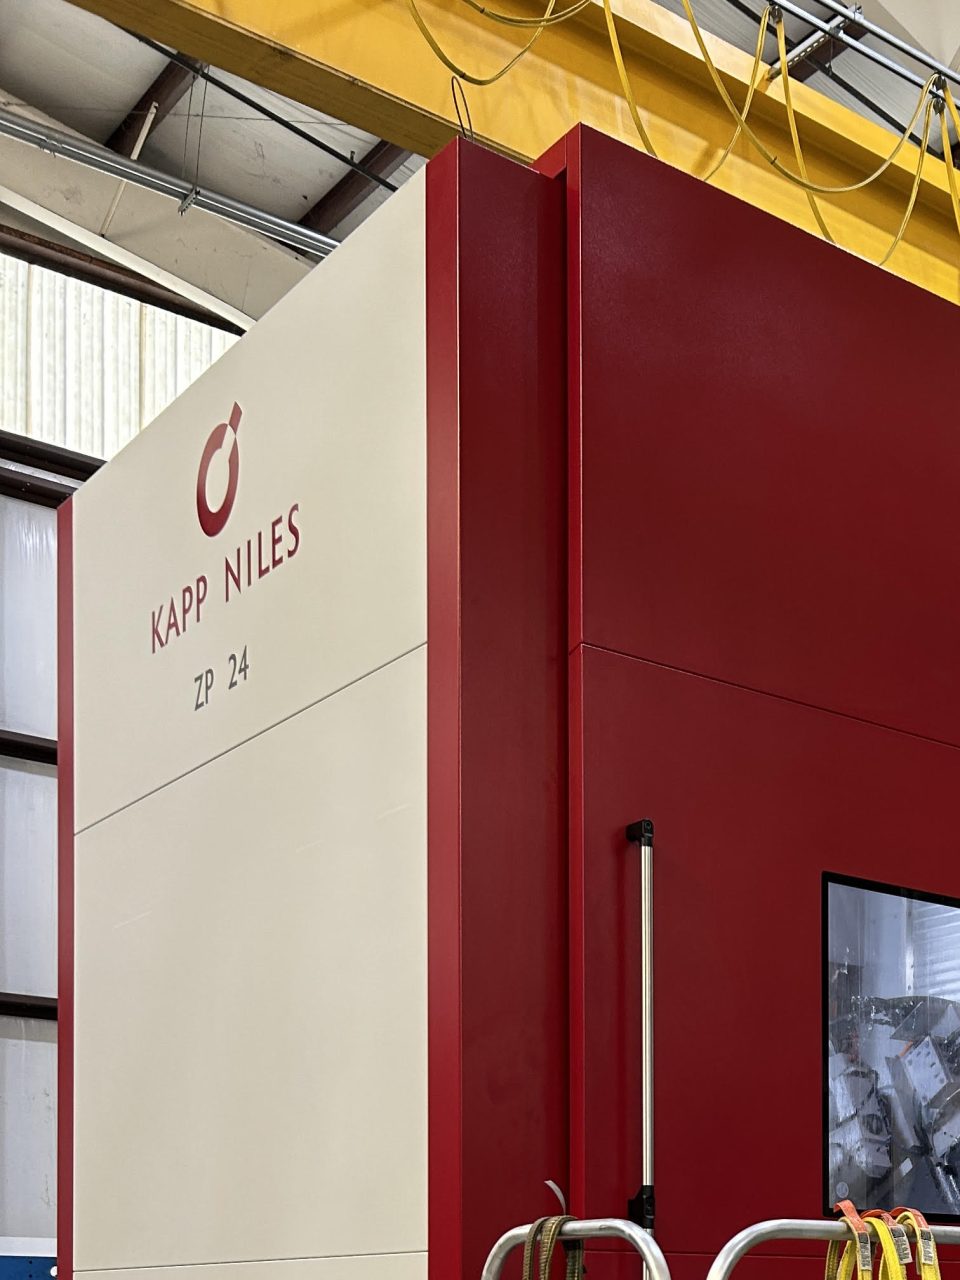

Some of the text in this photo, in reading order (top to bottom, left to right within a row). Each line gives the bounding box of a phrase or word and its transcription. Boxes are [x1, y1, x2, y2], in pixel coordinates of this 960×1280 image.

[151, 503, 300, 654] KAPP NILES
[194, 645, 249, 711] ZP 24
